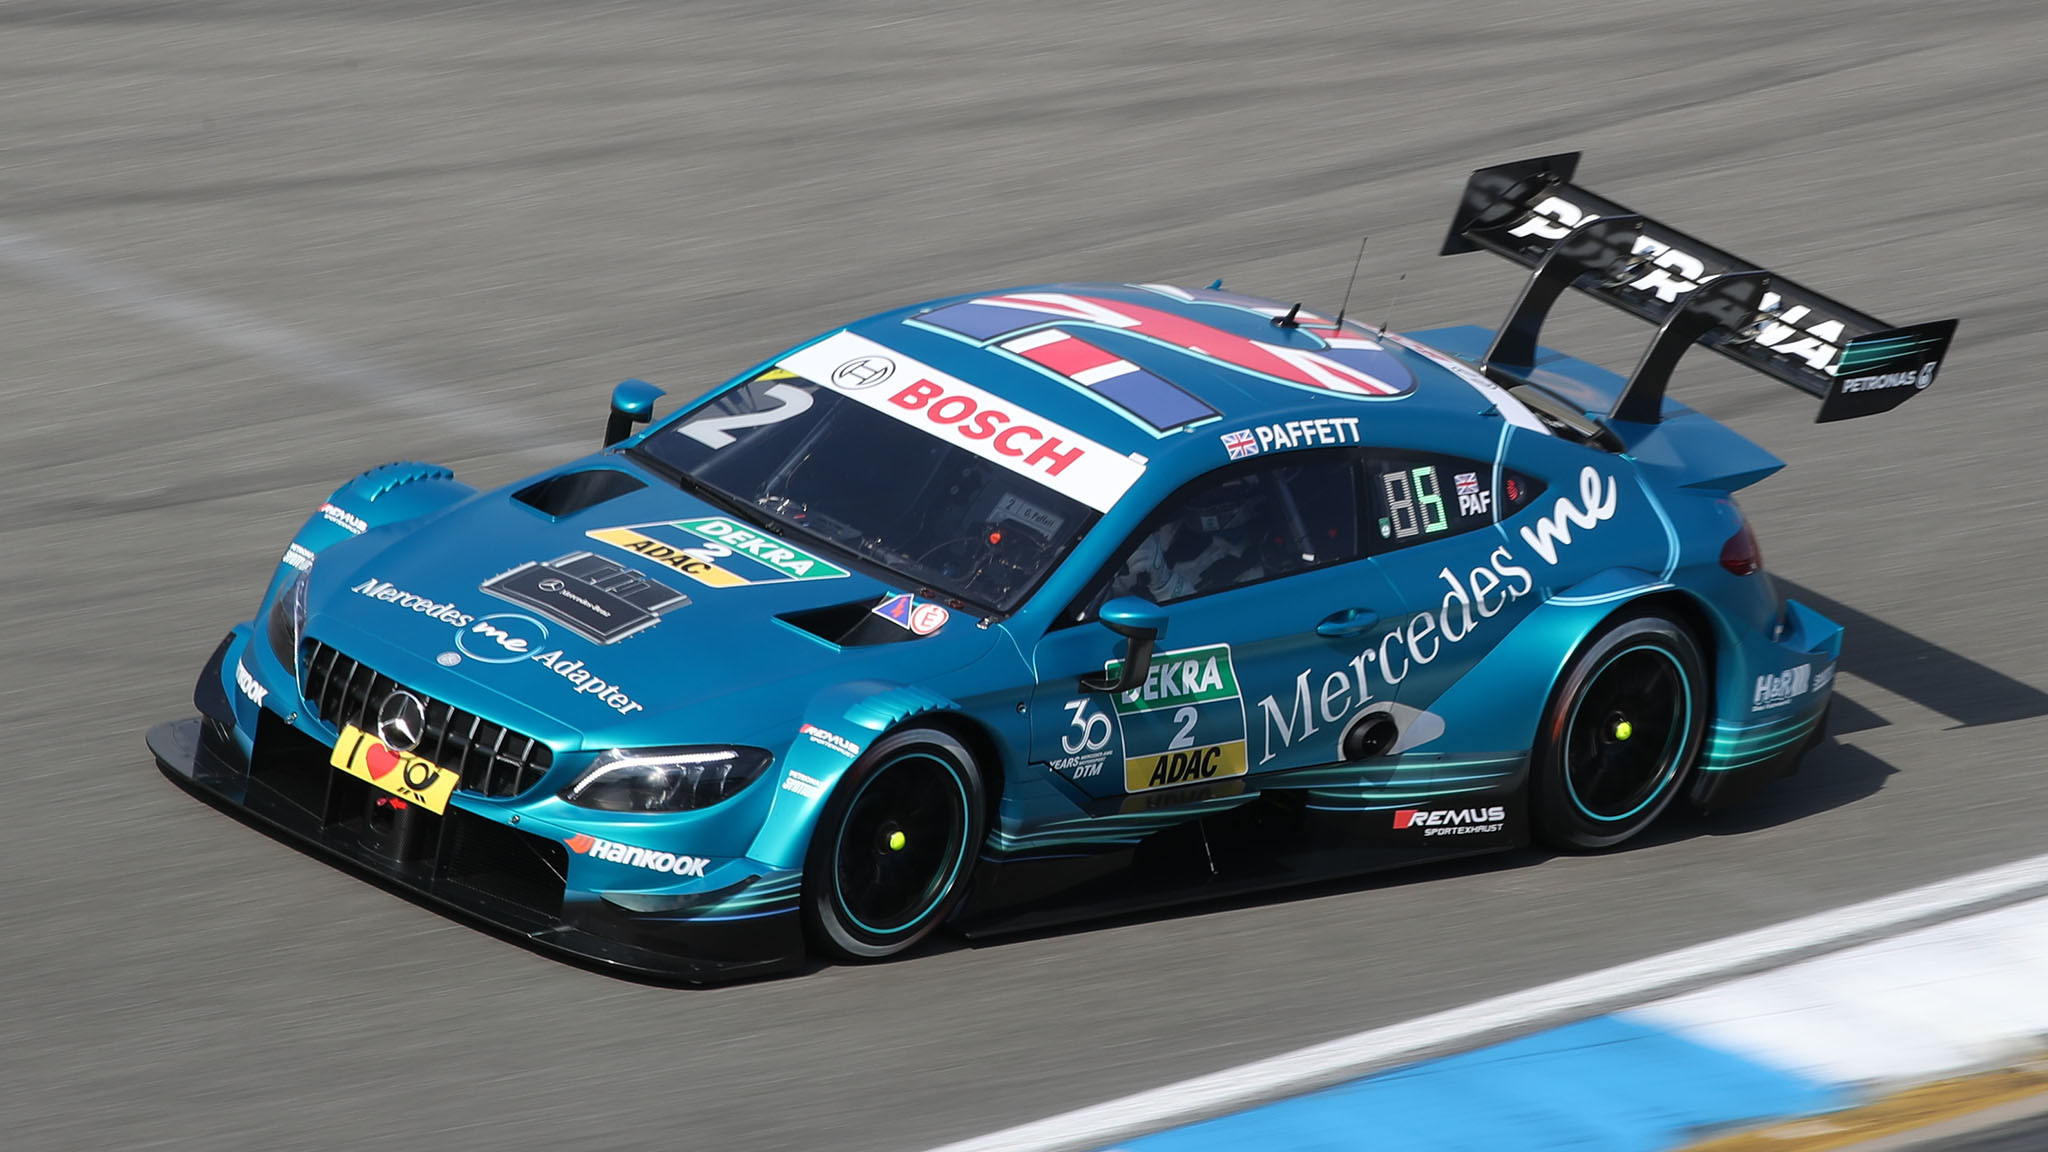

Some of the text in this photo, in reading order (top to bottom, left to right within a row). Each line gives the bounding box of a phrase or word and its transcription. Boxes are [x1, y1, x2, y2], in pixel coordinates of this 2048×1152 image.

[1841, 370, 1918, 394] PETRONAS
[676, 382, 815, 451] 2
[887, 378, 1085, 477] BOSCH
[1255, 416, 1361, 453] PAFFETT
[320, 503, 369, 532] REMUS
[1458, 490, 1492, 517] PAF
[623, 540, 713, 575] ADAC
[682, 541, 733, 563] 2
[695, 519, 815, 577] DEKRA
[1257, 464, 1618, 766] Mercedes me
[351, 577, 645, 717] Mercedes me Adapter
[803, 725, 861, 756] REMUS
[1061, 697, 1112, 755] 30
[1168, 706, 1198, 750] 2
[1049, 756, 1080, 772] YEARS
[1072, 762, 1104, 780] DTM
[1148, 746, 1221, 787] ADAC
[1407, 806, 1506, 828] REMUS
[1423, 823, 1504, 837] SPORTEXHAUST
